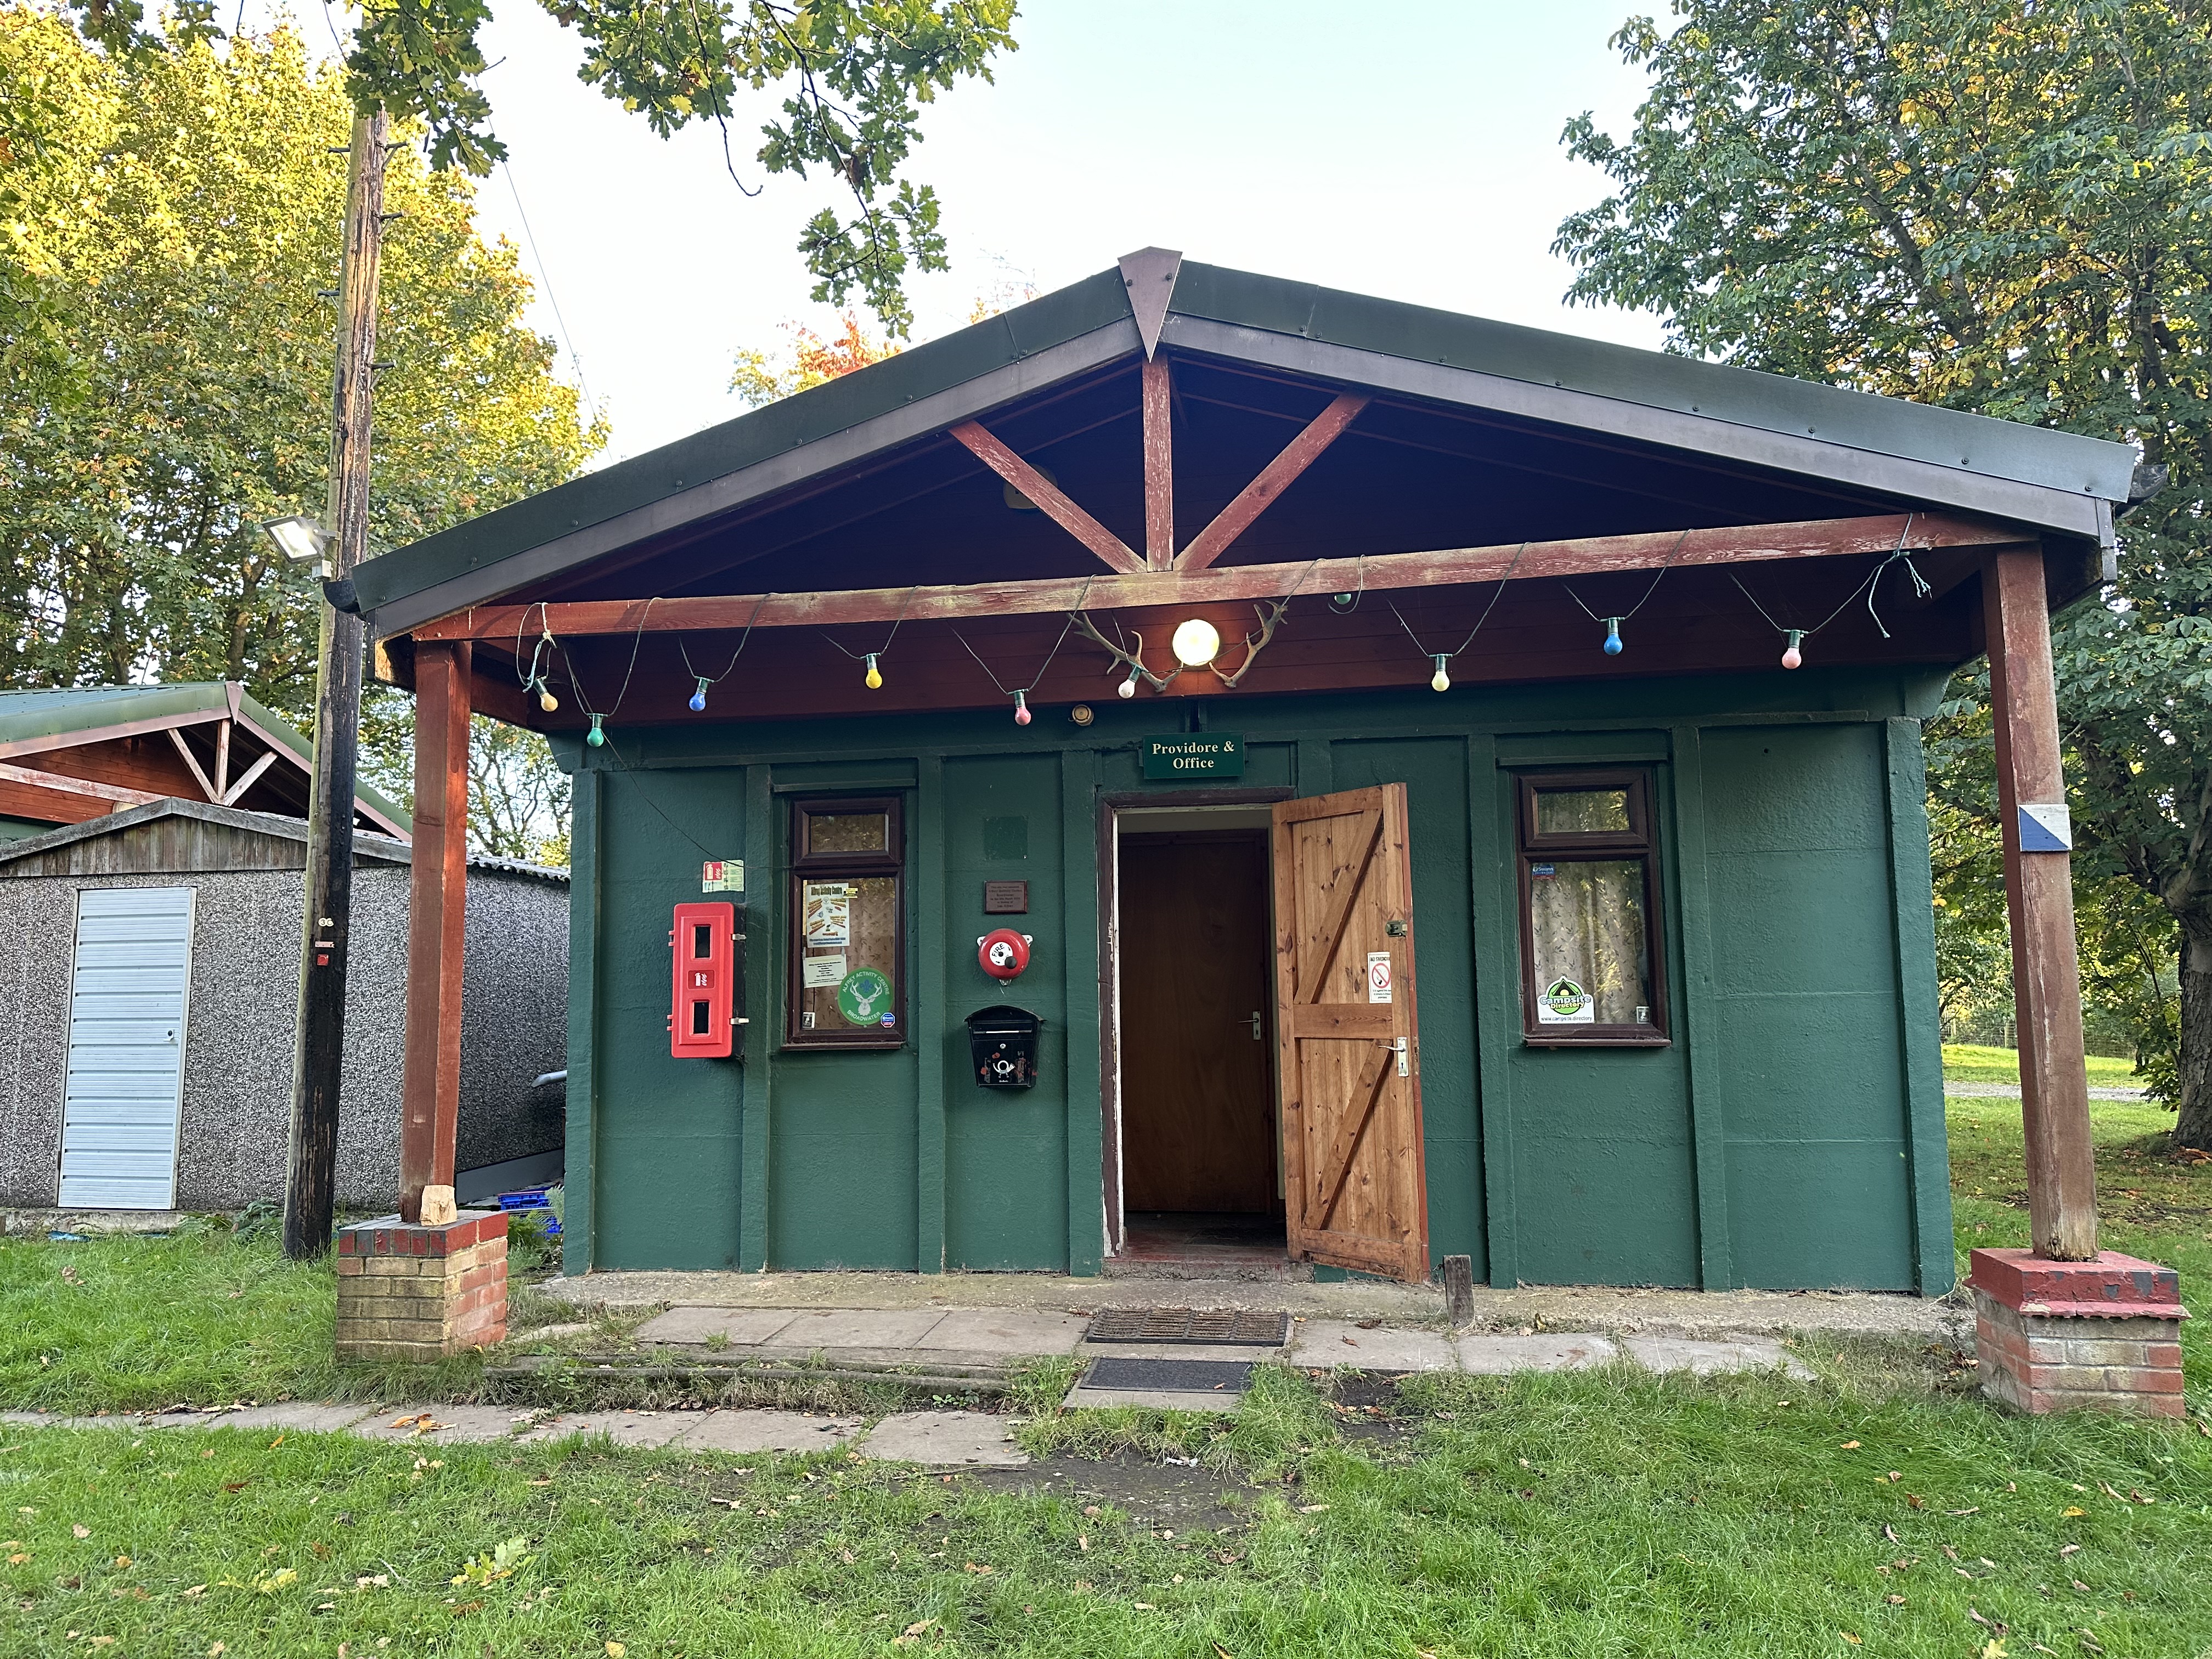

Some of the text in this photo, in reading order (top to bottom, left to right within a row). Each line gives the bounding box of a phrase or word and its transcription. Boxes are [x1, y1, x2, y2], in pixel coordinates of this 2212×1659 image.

[1152, 741, 1235, 754] Providore &
[1173, 757, 1214, 769] Office
[992, 944, 1005, 957] FIRE
[842, 975, 855, 992] ALFREY
[877, 977, 890, 995] CENTRE
[1539, 994, 1592, 1005] Campsite
[1550, 1001, 1584, 1009] Directory
[847, 1009, 881, 1021] BROADWATER
